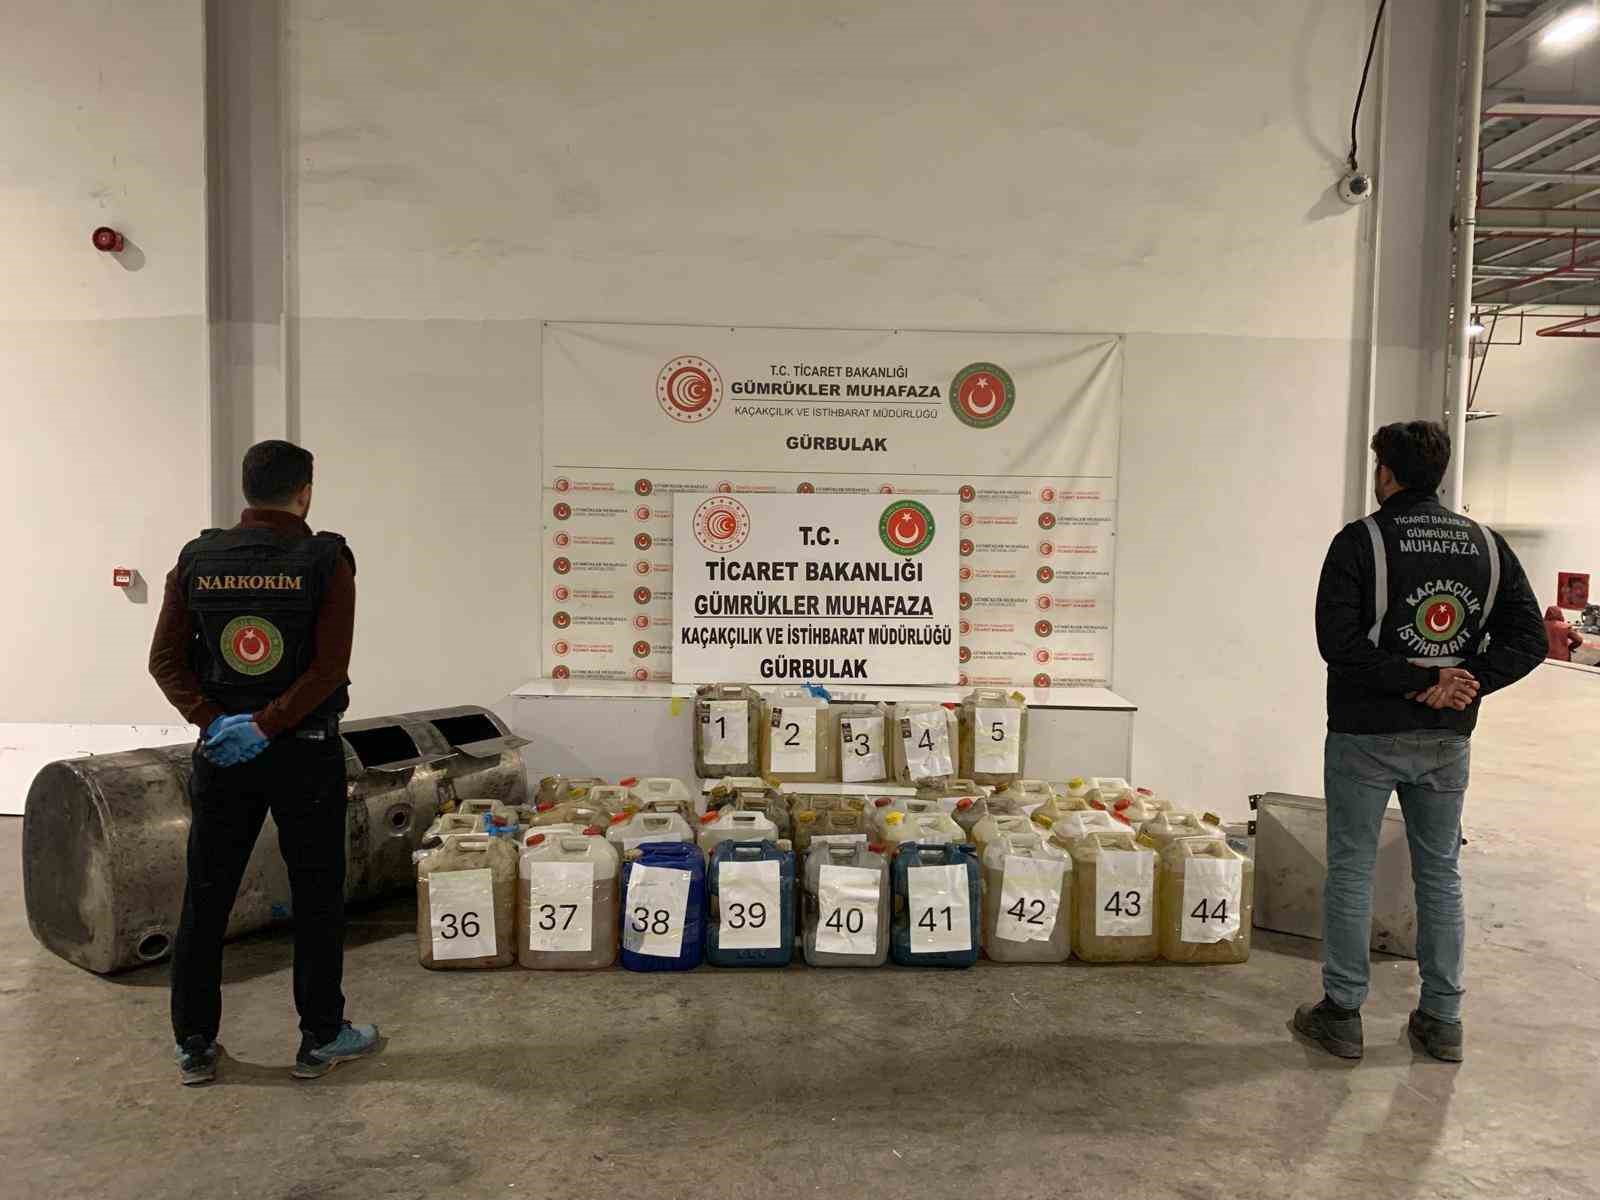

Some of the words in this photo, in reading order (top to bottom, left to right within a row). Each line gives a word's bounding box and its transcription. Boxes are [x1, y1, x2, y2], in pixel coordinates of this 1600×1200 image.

[769, 365, 791, 376] T.C.
[793, 363, 842, 377] TİCARET
[845, 364, 908, 379] BAKANLIĞI
[731, 379, 841, 397] GÜMRÜKLER
[846, 384, 941, 398] MUHAFAZA
[734, 405, 794, 418] KAÇAKÇILIK
[797, 407, 809, 416] VE
[872, 406, 938, 419] MÜDÜRLÜĞÜ
[786, 434, 888, 452] GÜRBULAK
[799, 526, 839, 546] T.C.
[1406, 527, 1470, 541] GÜMRÜKLER
[1400, 539, 1480, 556] MUHAFAZA
[197, 573, 303, 590] NARKOKİM
[705, 557, 799, 582] TİCARET
[805, 557, 923, 582] BAKANLIĞI
[694, 591, 820, 616] GÜMRÜKLER
[826, 595, 934, 616] MUHAFAZA
[1405, 579, 1481, 615] KAÇAKÇILIK
[681, 627, 762, 649] KAÇAKÇILIK
[767, 627, 784, 645] VE
[787, 623, 865, 645] İSTİHBARAT
[869, 624, 951, 645] MÜDÜRLÜĞÜ
[1396, 623, 1472, 657] İSTİHBARAT
[760, 654, 868, 679] GÜRBULAK
[715, 716, 725, 739] 1
[784, 723, 800, 746] 2
[918, 728, 935, 751] 4
[991, 721, 1004, 742] 5
[855, 733, 870, 757] 3
[728, 902, 767, 929] 39
[1007, 897, 1046, 926] 42
[1104, 890, 1142, 917] 43
[1190, 898, 1228, 924] 44
[440, 911, 480, 939] 36
[539, 904, 578, 932] 37
[631, 906, 670, 935] 38
[825, 907, 864, 934] 40
[918, 906, 953, 933] 41
